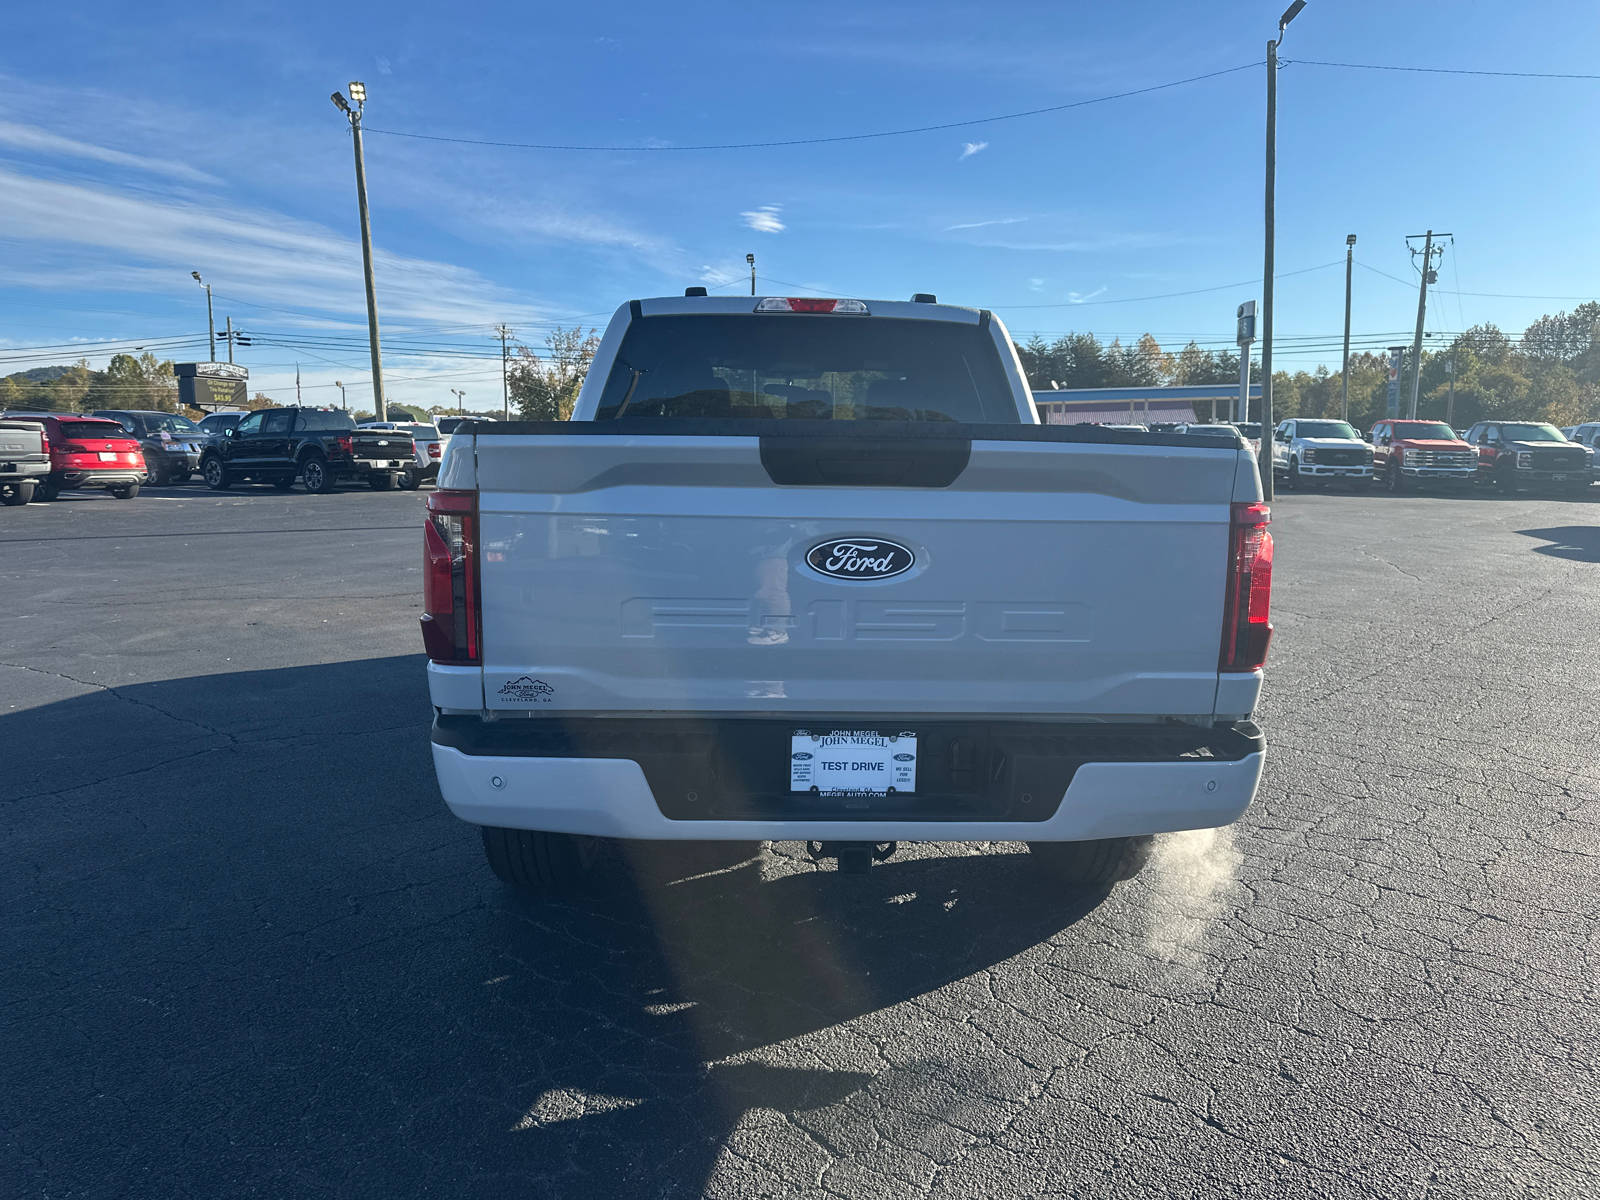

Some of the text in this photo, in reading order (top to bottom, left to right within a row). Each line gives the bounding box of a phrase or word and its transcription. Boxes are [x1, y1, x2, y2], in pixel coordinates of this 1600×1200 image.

[825, 543, 895, 572] Ford
[819, 736, 888, 748] JOHN MEGEL
[821, 762, 884, 771] TEST DRIVE
